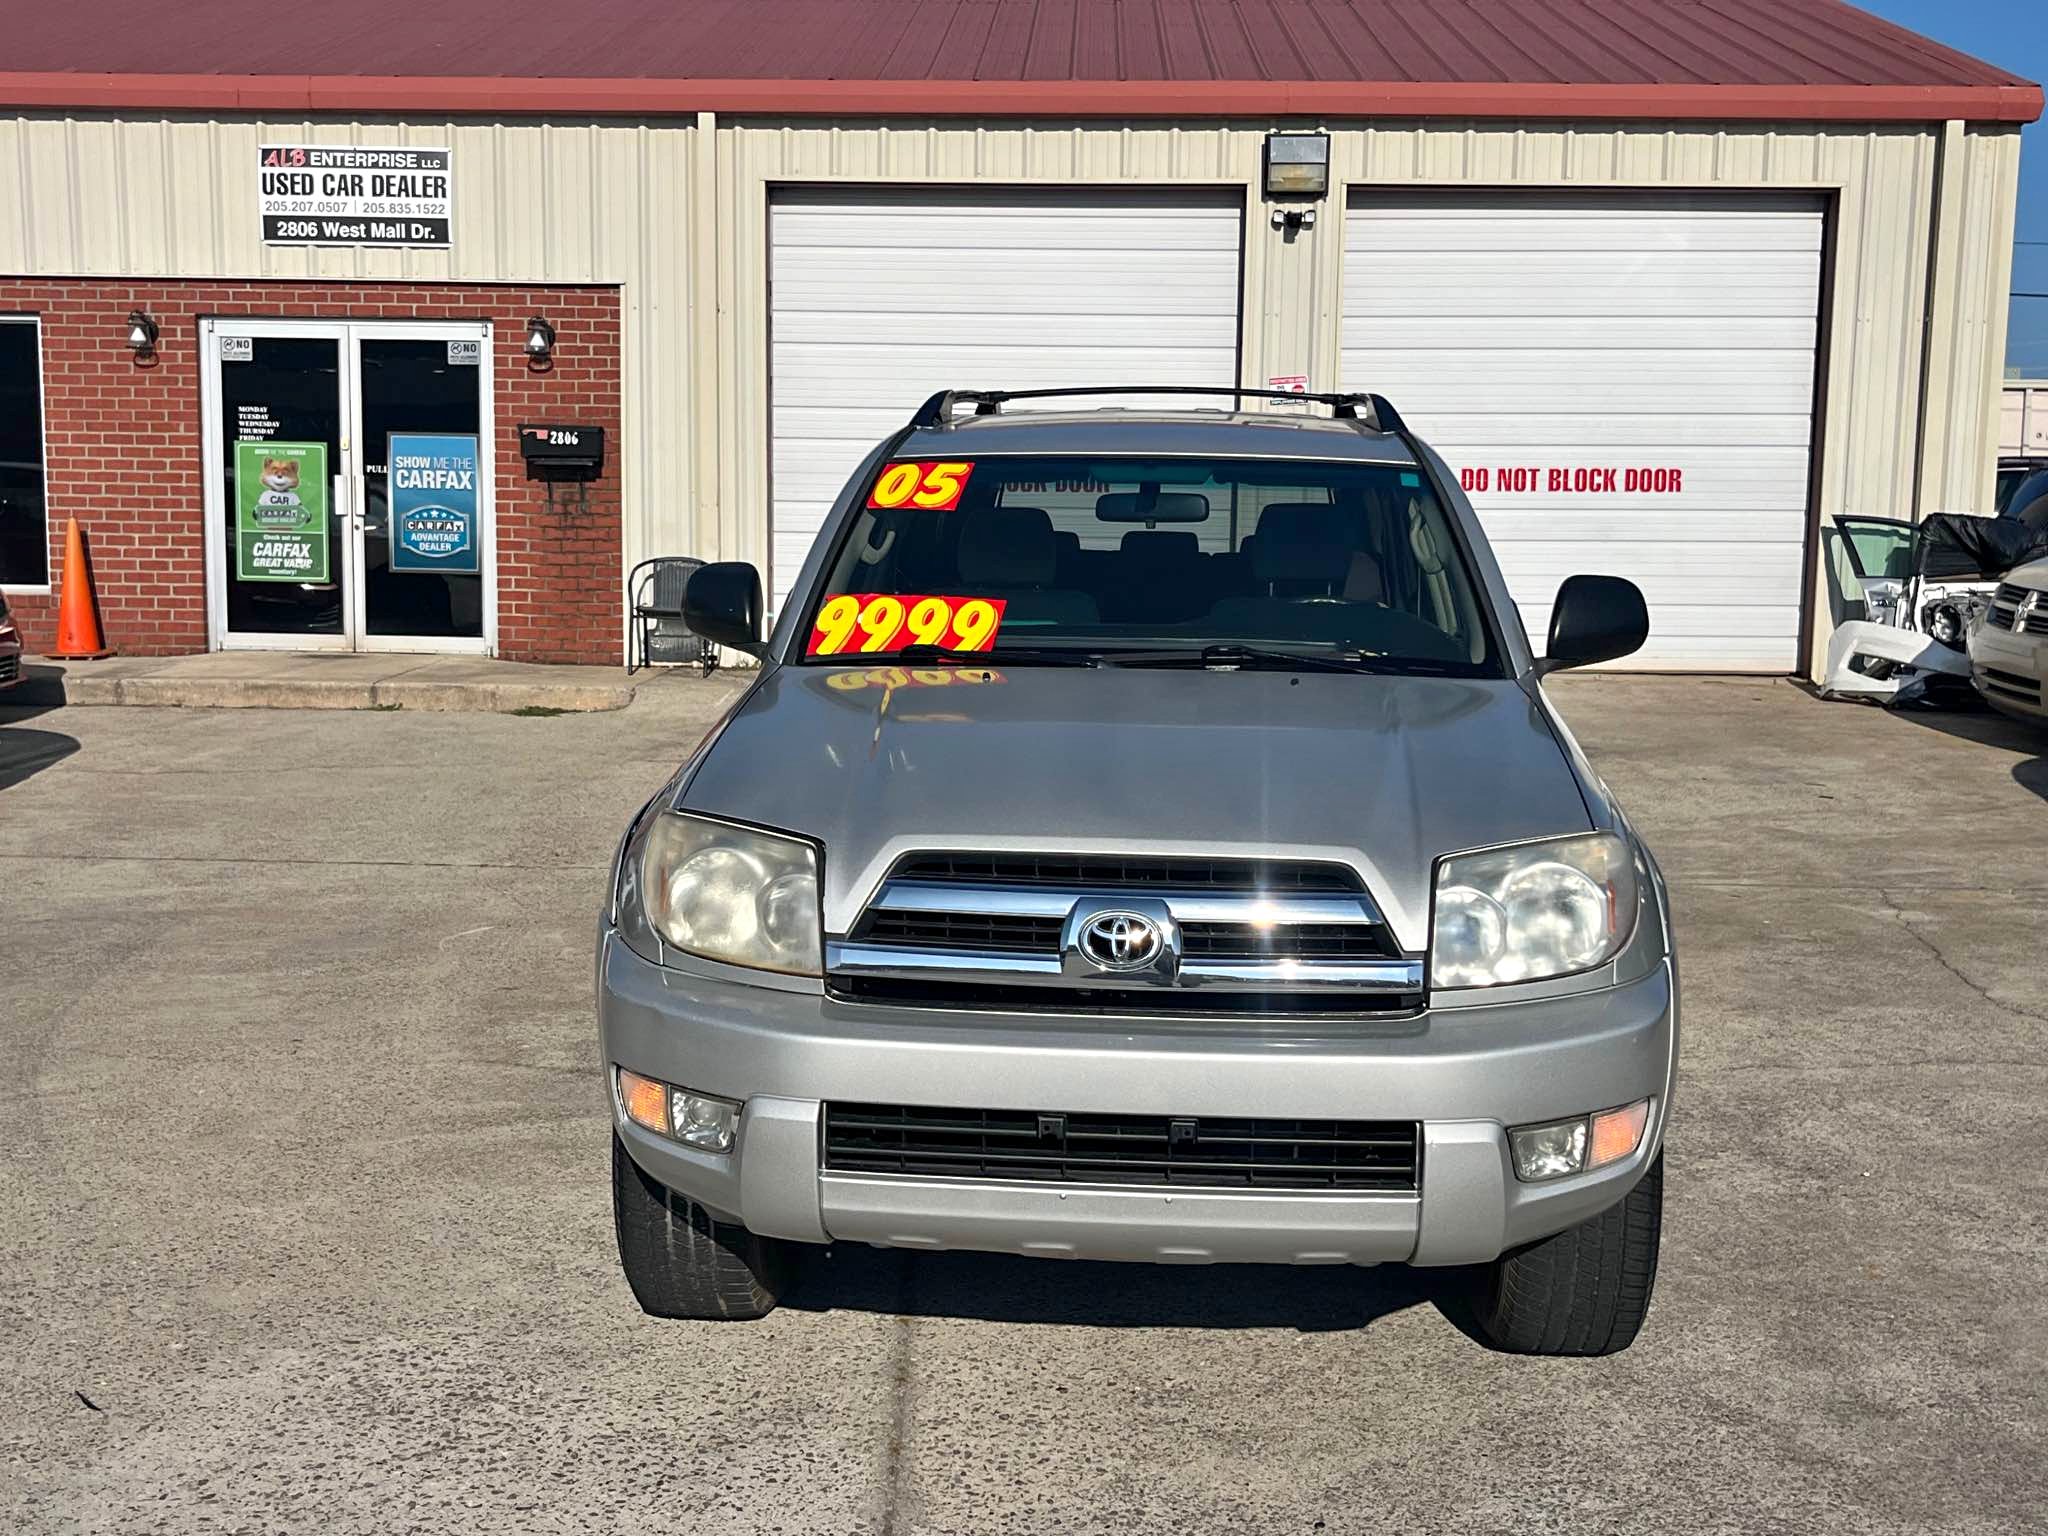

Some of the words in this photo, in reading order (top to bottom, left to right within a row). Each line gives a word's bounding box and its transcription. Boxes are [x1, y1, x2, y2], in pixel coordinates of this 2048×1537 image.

[264, 148, 306, 167] ALB
[310, 152, 418, 168] ENTERPRISE
[422, 160, 440, 168] LLC
[262, 173, 314, 196] USED
[322, 174, 364, 197] CAR
[372, 175, 447, 198] DEALER
[265, 201, 348, 214] 205.207.0507
[363, 202, 446, 215] 205.835.1522
[276, 221, 318, 237] 2806
[322, 222, 366, 238] West
[371, 223, 406, 239] Mall
[411, 224, 436, 239] Dr.
[236, 340, 250, 348] NO
[463, 344, 476, 352] NO
[238, 420, 280, 428] WEDNESDAY
[239, 427, 275, 435] THURSDAY
[550, 430, 579, 445] 2806
[396, 456, 430, 469] SHOW
[434, 457, 450, 469] ME
[453, 457, 472, 470] THE
[396, 470, 473, 490] CARFAX
[873, 463, 969, 508] 05
[1461, 468, 1489, 492] DO
[1497, 468, 1540, 492] NOT
[1548, 468, 1617, 493] BLOCK
[1624, 468, 1682, 493] DOOR
[270, 496, 289, 504] CAR
[406, 520, 464, 532] CARFAX
[410, 532, 460, 542] ADVANTAGE
[253, 542, 312, 558] CARFAX
[419, 542, 452, 551] DEALER
[253, 558, 282, 568] GREAT
[815, 595, 999, 656] 9999
